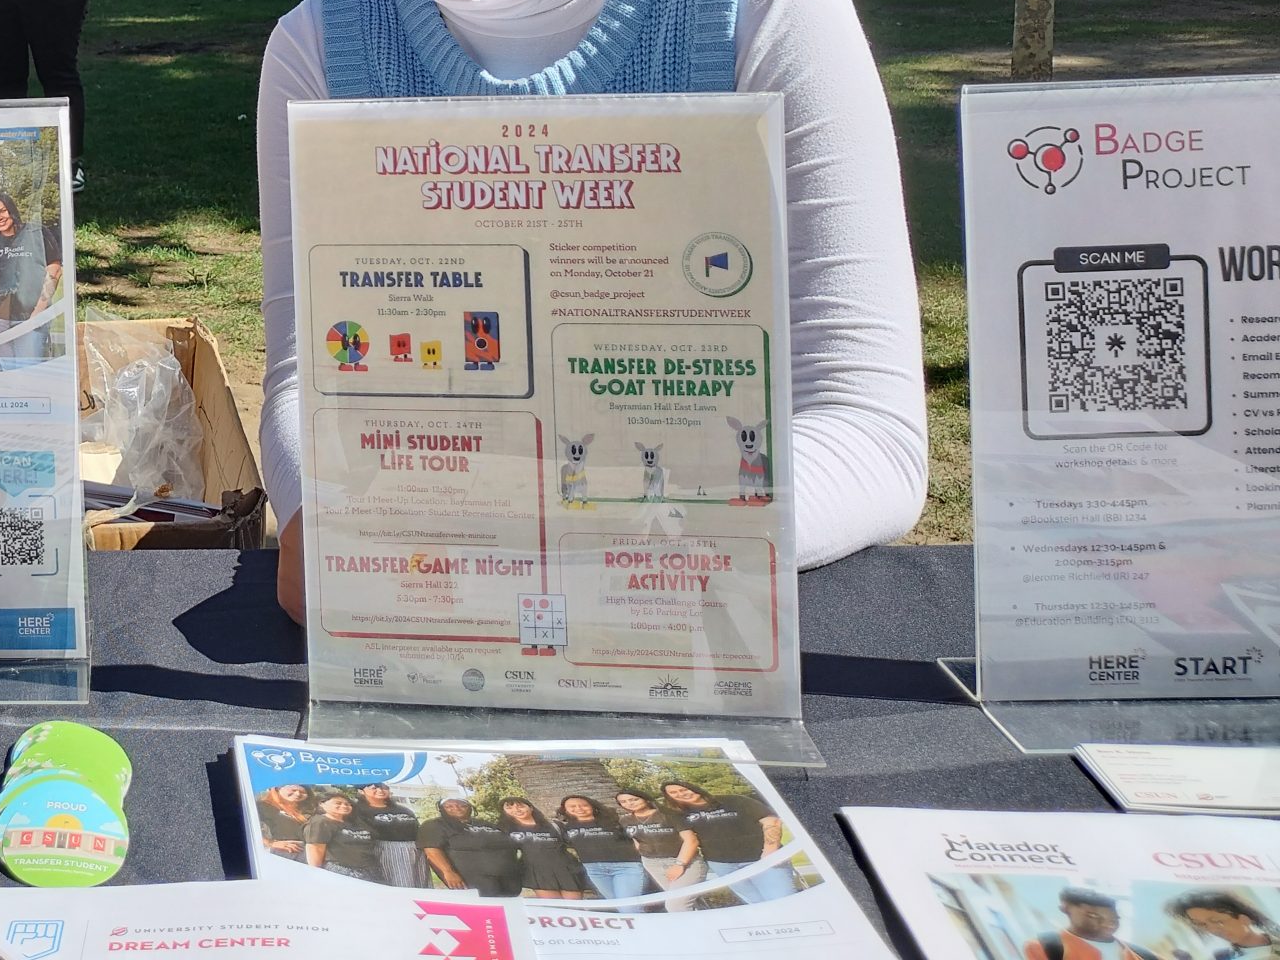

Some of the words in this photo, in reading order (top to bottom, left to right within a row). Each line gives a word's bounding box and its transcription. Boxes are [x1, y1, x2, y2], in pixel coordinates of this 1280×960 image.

[501, 123, 549, 138] 2024
[1094, 123, 1204, 156] BADGE
[533, 142, 681, 174] TRANSFER
[1121, 158, 1251, 190] PROJECT
[420, 179, 546, 210] STUDENT
[551, 178, 635, 210] WEEK
[474, 219, 523, 228] OCTOBER
[526, 219, 548, 228] 21ST
[557, 219, 583, 228] 25TH
[549, 243, 580, 252] Sticker
[582, 243, 637, 253] competition
[355, 257, 406, 266] TUESDAY,
[409, 257, 434, 265] OCT.
[439, 257, 465, 265] 22ND
[549, 256, 585, 265] winners
[587, 256, 604, 265] will
[606, 256, 617, 265] be
[619, 256, 669, 265] announced
[1079, 252, 1120, 265] SCAN
[1124, 251, 1146, 263] ME
[1218, 244, 1280, 282] WOR
[339, 271, 425, 288] TRANSFER
[430, 271, 483, 288] TABLE
[550, 269, 562, 278] on
[564, 269, 603, 279] Monday,
[604, 269, 642, 278] October
[643, 269, 654, 278] 21
[388, 294, 412, 302] Sierra
[413, 294, 434, 302] Walk
[549, 289, 646, 300] @csun_badge_project
[377, 308, 409, 316] 11:30am
[415, 308, 447, 318] 2:30pm
[551, 308, 751, 319] #NATIONALTRANSFERSTUDENTWEEK
[593, 344, 667, 353] WEDNESDAY,
[670, 344, 696, 352] OCT.
[700, 344, 728, 352] 23RD
[1242, 351, 1273, 361] Email
[568, 357, 656, 375] TRANSFER
[663, 358, 757, 376] DE-STRESS
[589, 378, 646, 396] GOAT
[651, 379, 735, 397] THERAPY
[10, 401, 29, 409] 2024
[609, 402, 652, 412] Bayramian
[654, 402, 671, 411] Hall
[674, 403, 692, 411] East
[694, 403, 717, 412] Lawn
[1243, 408, 1260, 418] CV
[1262, 409, 1275, 417] vs
[364, 419, 424, 429] THURSDAY,
[427, 420, 453, 429] OCT.
[456, 421, 482, 429] 24TH
[627, 417, 701, 427] 10:30am-12:30pm
[407, 435, 483, 452] STUDENT
[1062, 444, 1087, 454] Scan
[419, 455, 470, 473] TOUR
[1036, 500, 1083, 510] Tuesdays
[1023, 543, 1088, 553] Wednesdays
[325, 555, 410, 574] TRANSFER
[417, 557, 469, 575] GAME
[604, 551, 653, 569] ROPE
[659, 553, 733, 572] COURSE
[400, 580, 424, 589] Sierra
[425, 581, 442, 589] Hall
[433, 595, 464, 605] 7:30pm
[18, 617, 50, 627] HERE
[18, 627, 51, 635] CENTER
[1089, 654, 1139, 670] HERE
[1174, 656, 1252, 676] START
[353, 668, 383, 678] HERE
[504, 670, 535, 680] CSUN
[1089, 670, 1139, 682] CENTER
[353, 678, 383, 686] CENTER
[557, 678, 589, 689] CSUN
[648, 689, 689, 698] EMBARC
[299, 751, 364, 766] BADGE
[317, 763, 392, 777] PROJECT
[1133, 791, 1179, 800] CSUN
[47, 800, 87, 812] PROUD
[941, 833, 1060, 853] Matador
[944, 848, 1077, 866] Connect
[1152, 851, 1266, 871] CSUN
[14, 857, 62, 866] TRANSFER
[63, 859, 109, 872] STUDENT
[134, 925, 214, 934] UNIVERSITY
[286, 924, 330, 932] UNION
[108, 939, 191, 952] DREAM
[198, 937, 291, 949] CENTER
